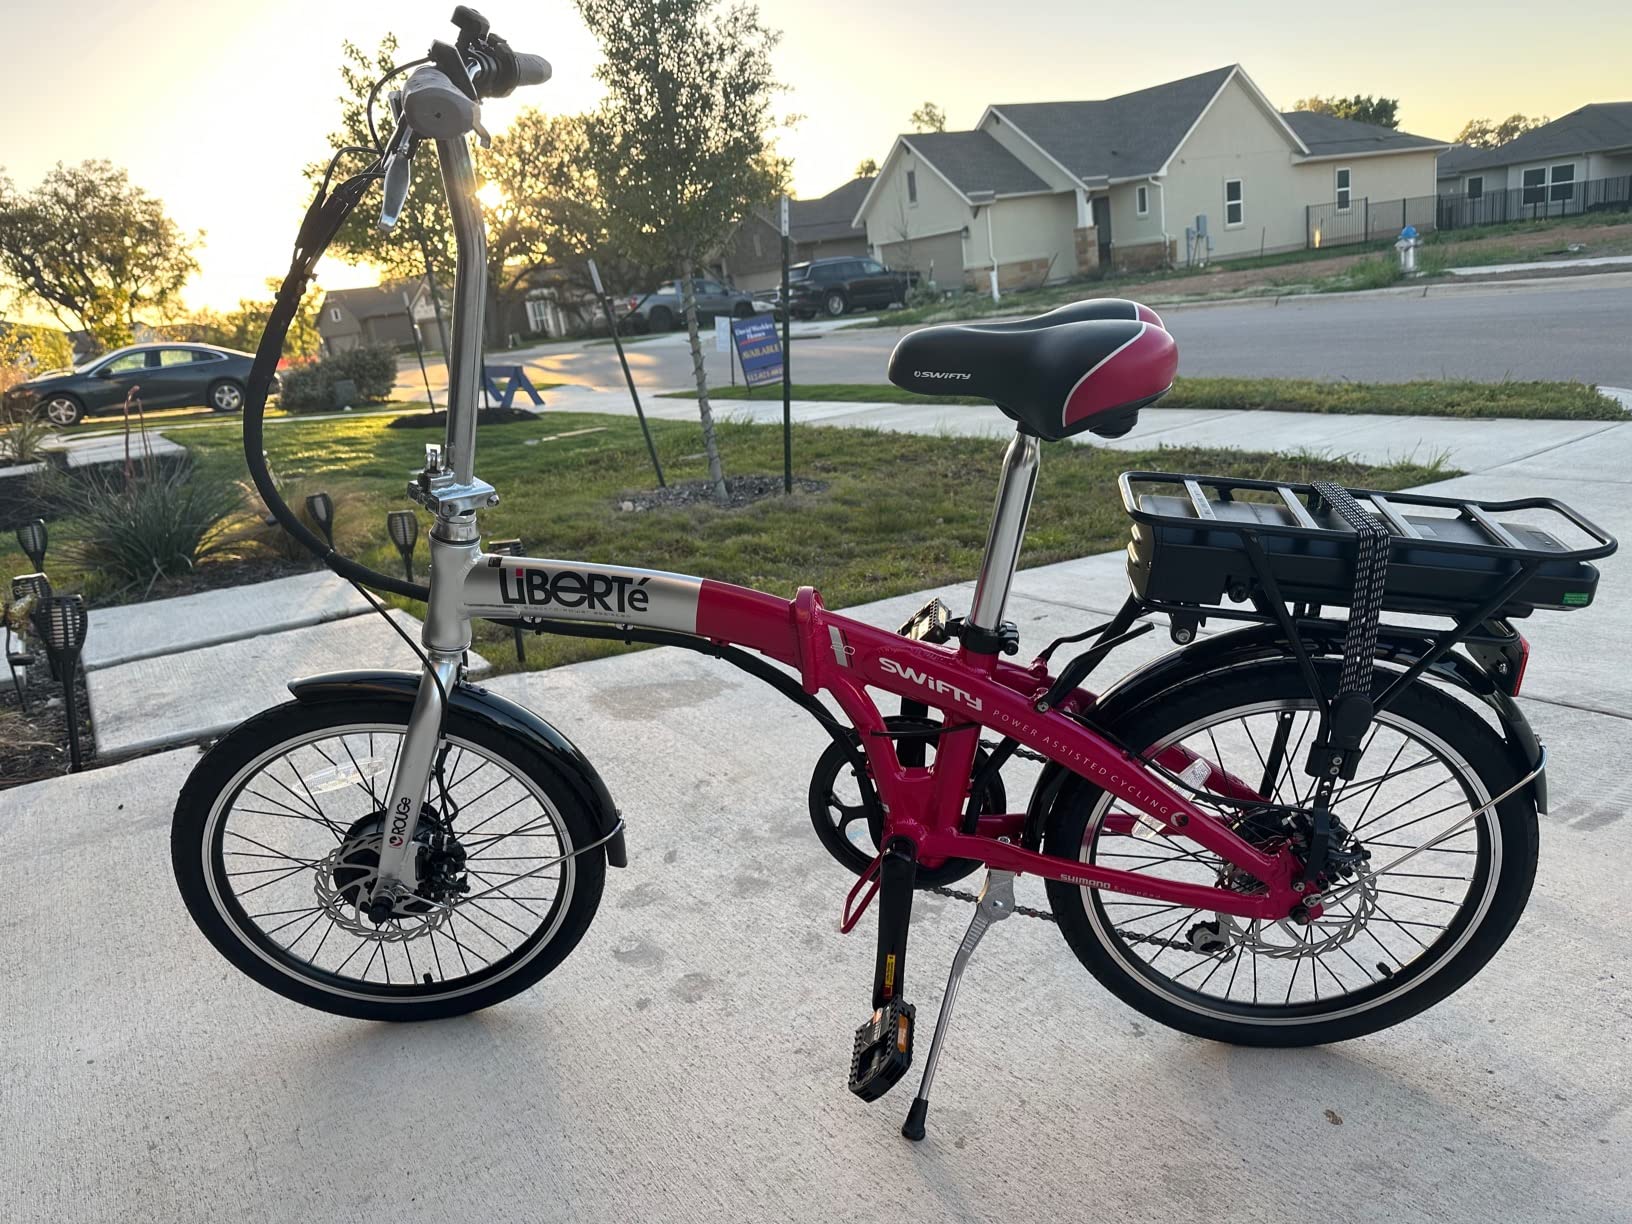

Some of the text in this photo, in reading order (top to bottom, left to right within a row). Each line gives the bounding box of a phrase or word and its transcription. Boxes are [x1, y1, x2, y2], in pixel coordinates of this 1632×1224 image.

[742, 344, 779, 360] AVAILABLE
[992, 709, 1038, 737] POWER
[1042, 736, 1107, 776] ASSISTED
[1110, 774, 1168, 815] CYCLING
